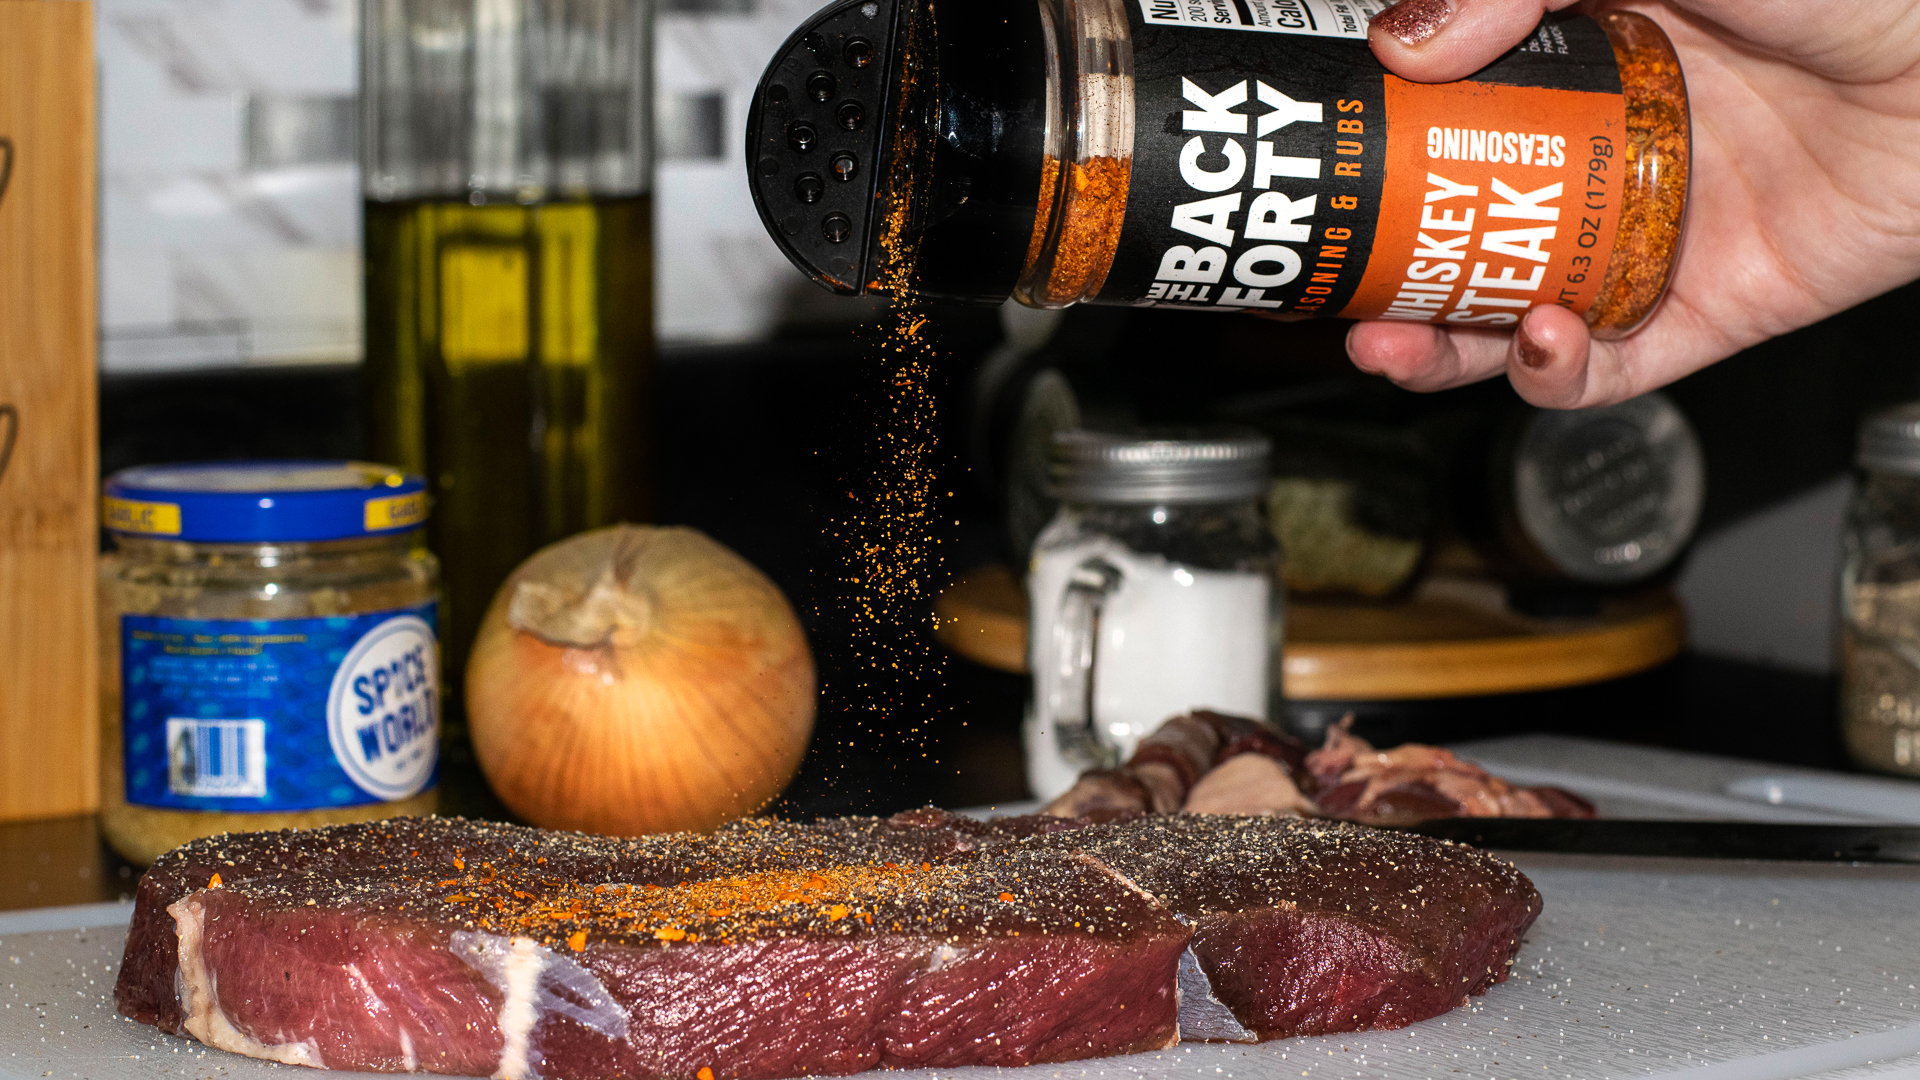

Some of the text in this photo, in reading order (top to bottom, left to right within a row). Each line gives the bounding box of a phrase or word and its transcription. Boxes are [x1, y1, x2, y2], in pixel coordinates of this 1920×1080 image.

[1187, 6, 1208, 22] 200
[1339, 14, 1358, 33] Total
[1427, 126, 1566, 167] SEASONING
[1584, 135, 1613, 210] (179g)
[1154, 76, 1248, 284] BACK
[1215, 79, 1323, 308] FORTY
[1294, 99, 1364, 312] ASONING & RUBS
[1378, 171, 1479, 321] WHISKEY
[1445, 176, 1563, 325] STEAK
[1577, 216, 1601, 248] OZ
[1145, 282, 1211, 302] THE
[1566, 255, 1592, 284] 6.3
